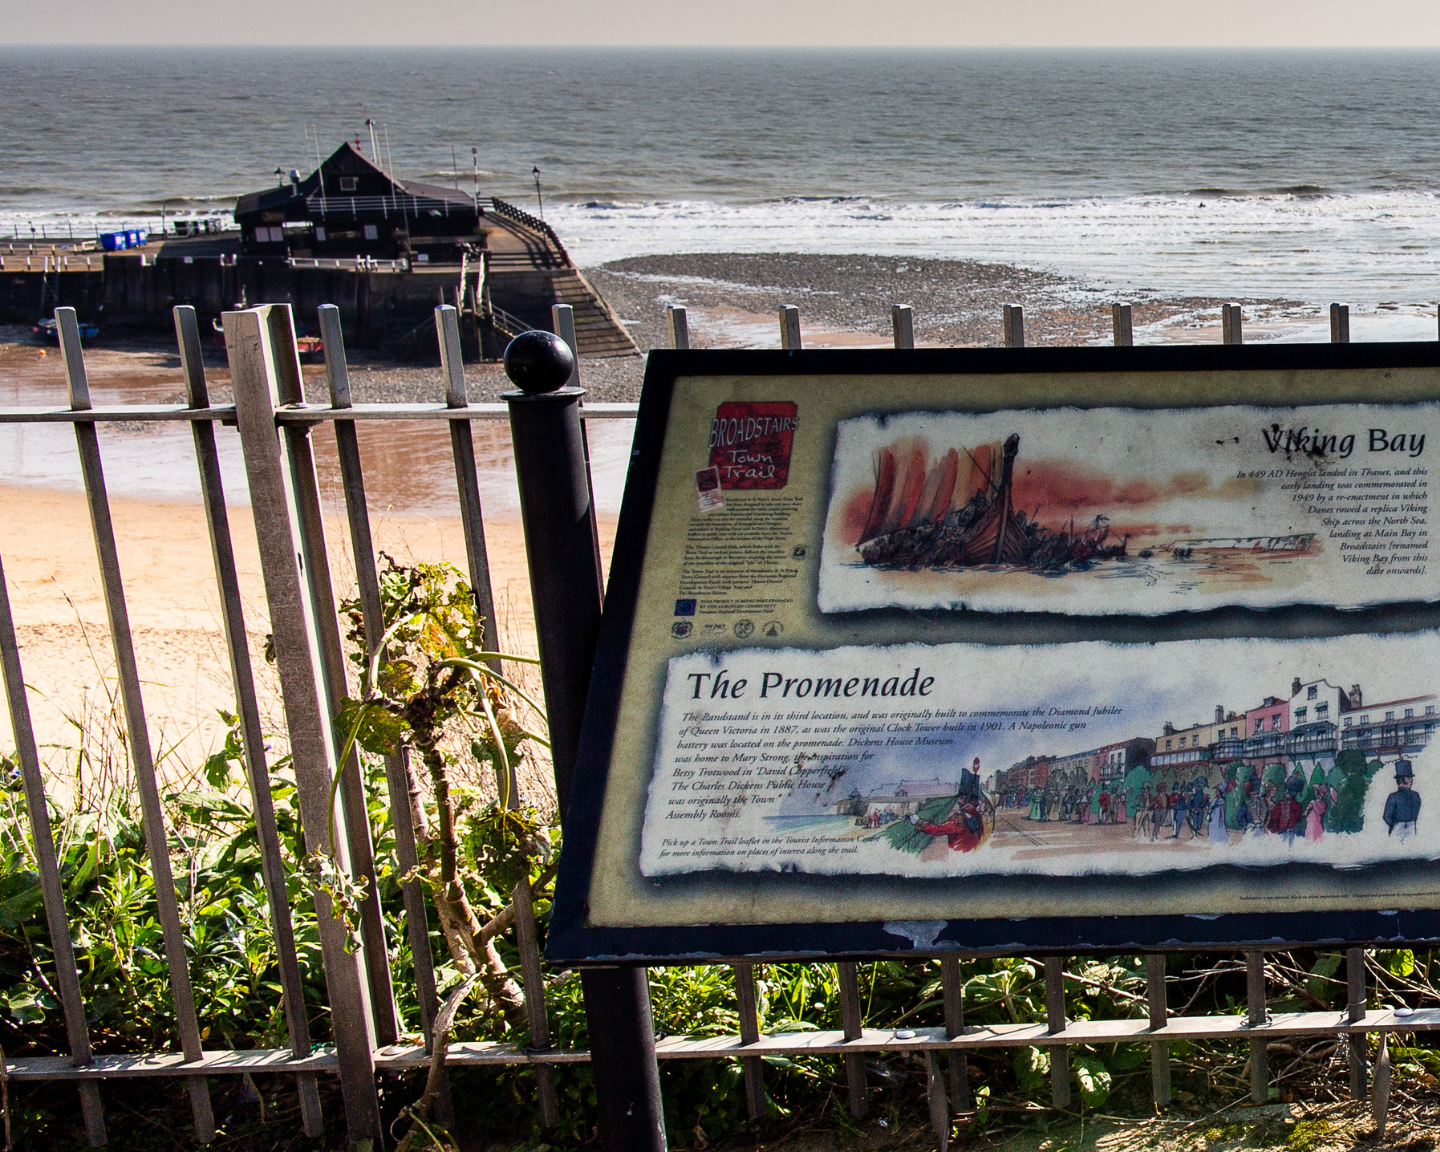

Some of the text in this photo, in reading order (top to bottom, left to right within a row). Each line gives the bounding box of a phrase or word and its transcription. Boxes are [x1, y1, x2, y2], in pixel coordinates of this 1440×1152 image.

[708, 416, 800, 448] BROADSTAIRS
[1261, 427, 1426, 459] Viking Bay
[727, 449, 773, 463] Town
[722, 464, 775, 478] Trail
[1236, 470, 1246, 478] In
[1248, 470, 1266, 478] 449
[1267, 469, 1283, 477] AD
[1285, 467, 1316, 479] Hengist
[1318, 467, 1347, 476] landed
[1348, 468, 1357, 476] in
[1393, 467, 1411, 475] and
[1412, 466, 1427, 475] this
[1280, 481, 1301, 491] early
[1302, 480, 1335, 491] landing
[1354, 479, 1417, 488] commemorated
[1418, 479, 1427, 487] in
[1292, 493, 1314, 501] 1949
[1316, 492, 1326, 504] by
[1402, 490, 1428, 499] which
[1307, 505, 1333, 513] Danes
[1335, 504, 1362, 513] rowed
[1370, 504, 1398, 515] replica
[1400, 503, 1428, 514] Viking
[1321, 517, 1340, 528] Ship
[1368, 516, 1381, 525] the
[1382, 515, 1408, 524] North
[1329, 529, 1361, 540] landing
[1374, 529, 1398, 537] Main
[1400, 528, 1416, 539] Bay
[1339, 541, 1386, 550] Broadstairs
[1342, 552, 1428, 564] Viking Bay from this
[1365, 565, 1385, 574] date
[687, 667, 935, 699] The Promenade
[682, 712, 699, 722] The
[786, 710, 810, 720] third
[850, 709, 870, 719] and
[890, 709, 932, 721] originally
[934, 708, 956, 717] built
[1031, 707, 1045, 716] the
[1048, 706, 1091, 716] Diamond
[1090, 705, 1122, 716] Jubilee
[678, 726, 691, 738] of
[689, 726, 719, 737] Queen
[723, 725, 757, 734] Victoria
[832, 723, 847, 733] the
[848, 723, 885, 735] original
[886, 722, 912, 732] Clock
[915, 723, 941, 731] Tower
[942, 722, 964, 731] built
[1007, 721, 1015, 730] A
[1018, 720, 1067, 732] Napoleonic
[1068, 722, 1086, 731] gun
[676, 739, 708, 751] battery
[729, 738, 762, 748] located
[776, 738, 791, 747] the
[847, 737, 883, 746] Dickens
[885, 737, 913, 745] House
[914, 736, 953, 745] Museum
[693, 753, 719, 762] home
[731, 753, 757, 764] Mary
[858, 751, 874, 762] for
[672, 768, 695, 779] Betsy
[699, 766, 741, 776] Trotwood
[671, 779, 827, 790] The Charles Dickens Public House
[687, 794, 731, 807] originally
[732, 794, 748, 804] the
[751, 794, 775, 803] Town
[665, 809, 707, 821] Assembly
[661, 838, 678, 846] Pick
[720, 837, 738, 845] Trail
[738, 837, 760, 846] leaflet
[811, 836, 854, 845] Information
[658, 850, 671, 859] for
[691, 849, 735, 857] information
[746, 848, 768, 858] places
[769, 848, 778, 856] of
[806, 847, 826, 855] along
